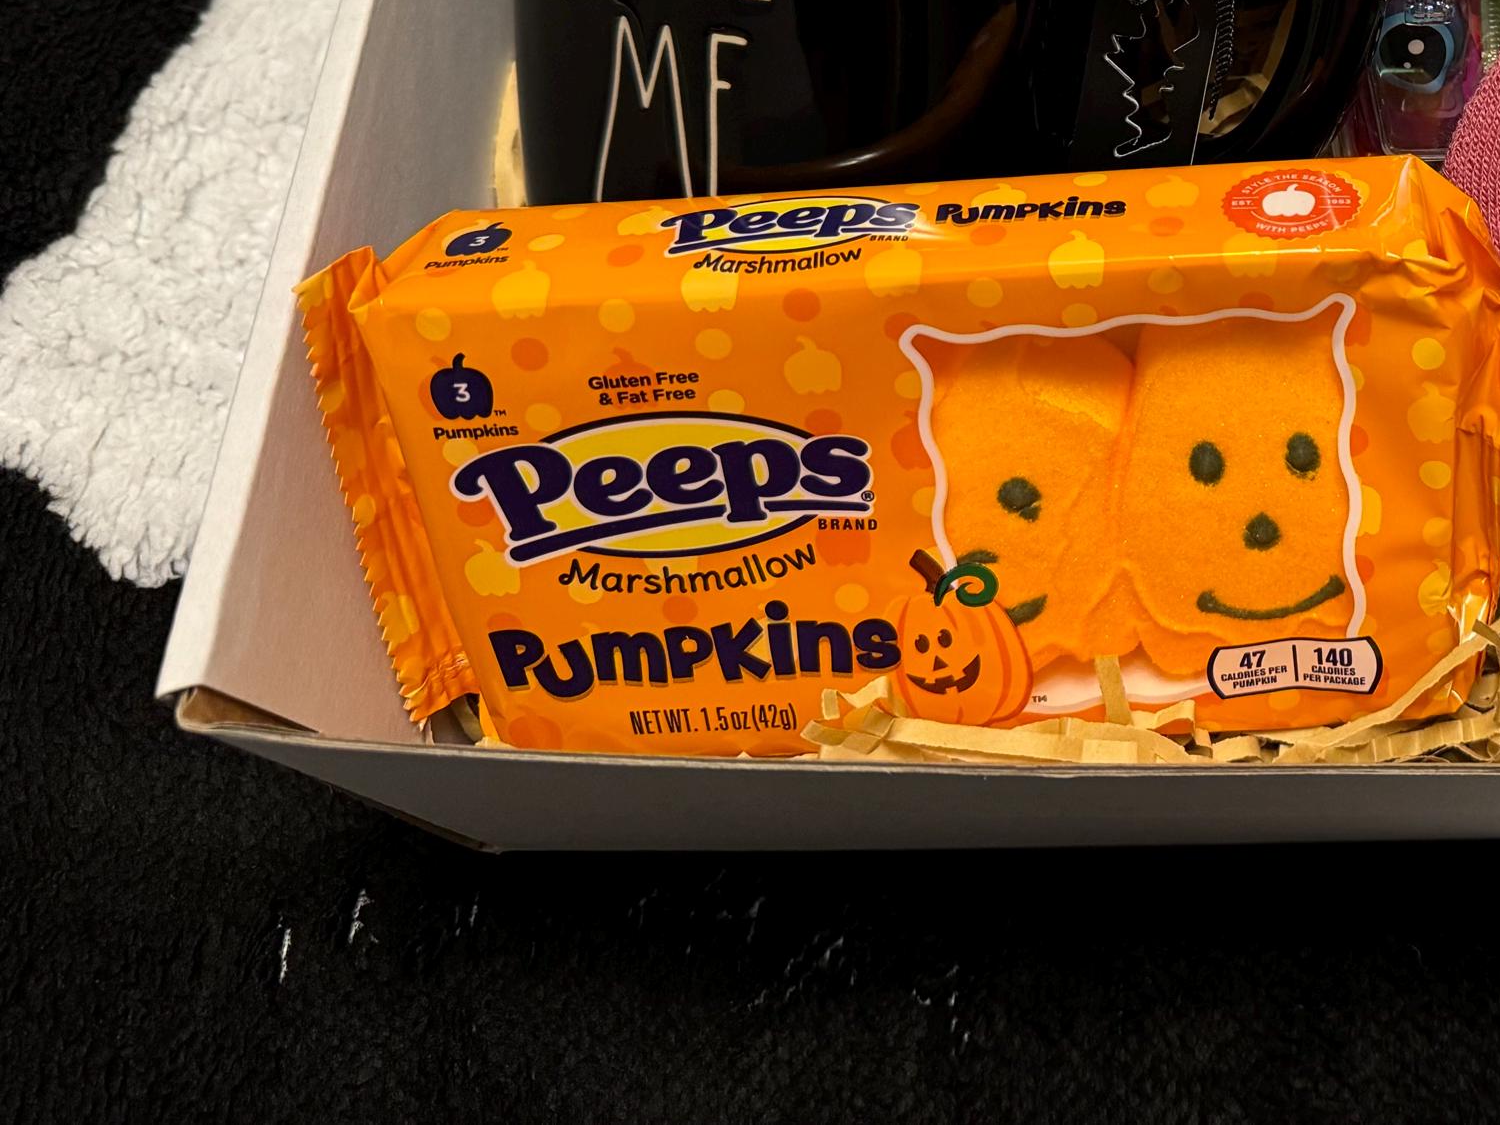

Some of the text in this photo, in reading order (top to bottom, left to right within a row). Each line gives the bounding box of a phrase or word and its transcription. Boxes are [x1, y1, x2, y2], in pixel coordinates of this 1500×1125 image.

[1302, 174, 1342, 193] SEASON
[1255, 222, 1286, 233] WITH
[469, 236, 490, 247] 3
[870, 234, 909, 243] BRAND
[424, 256, 510, 269] Pumpkins
[693, 248, 862, 275] Marshmallow
[588, 372, 699, 390] Gluten Free
[453, 383, 471, 403] 3
[599, 387, 696, 406] & Fat Free
[433, 424, 519, 440] Pumpkins
[818, 519, 879, 532] BRAND
[558, 542, 817, 595] Marshmallow
[1239, 649, 1266, 669] 47
[1313, 648, 1353, 667] 140
[1220, 665, 1288, 682] CALORIES PER
[1311, 665, 1356, 676] CALORIES
[1232, 676, 1278, 689] PUMPKIN
[1303, 673, 1366, 685] PER PACKAGE
